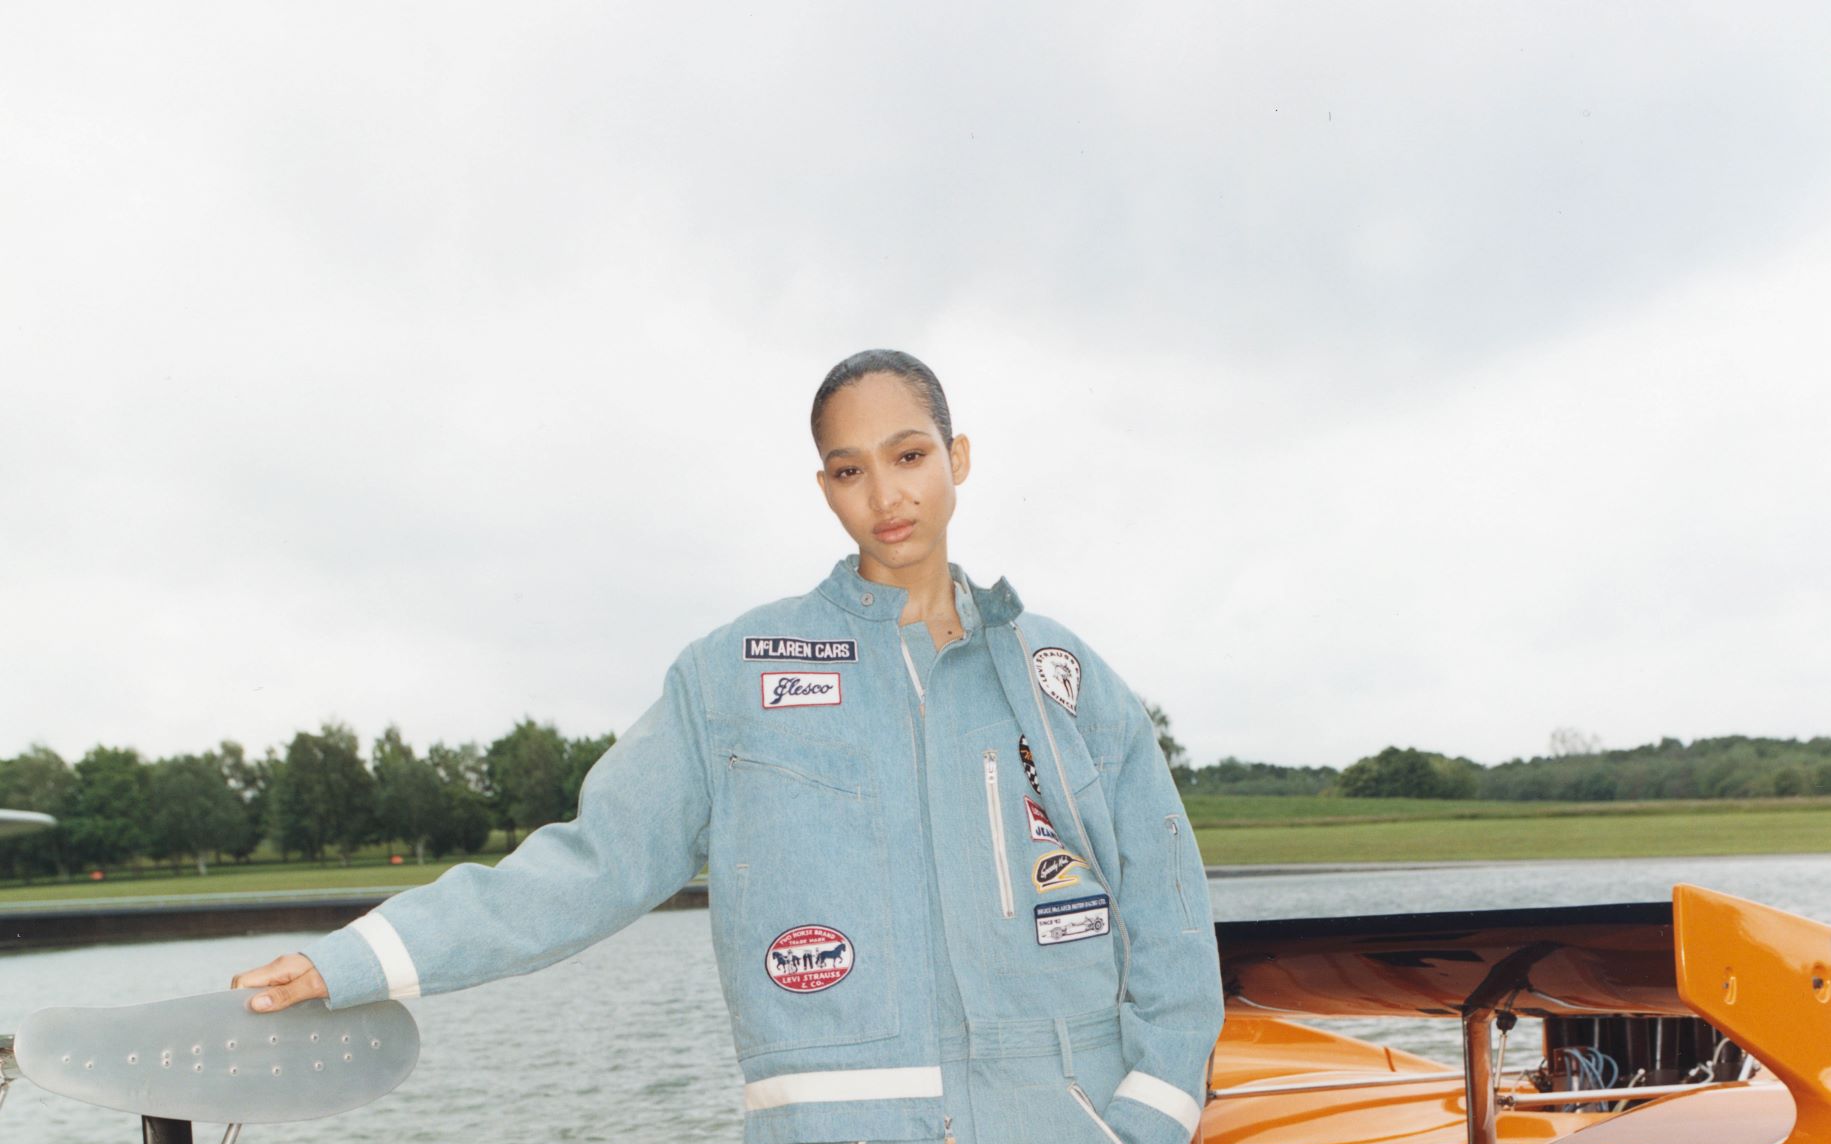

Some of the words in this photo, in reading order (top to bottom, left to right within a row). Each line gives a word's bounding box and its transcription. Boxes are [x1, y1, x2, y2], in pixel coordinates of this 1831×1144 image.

[751, 640, 812, 658] McLAREN
[815, 643, 850, 658] CARS
[780, 934, 792, 945] TWO
[792, 929, 813, 939] HORSE
[814, 929, 836, 940] BRAND
[782, 975, 800, 984] LEVI
[803, 971, 841, 982] STRAUSS
